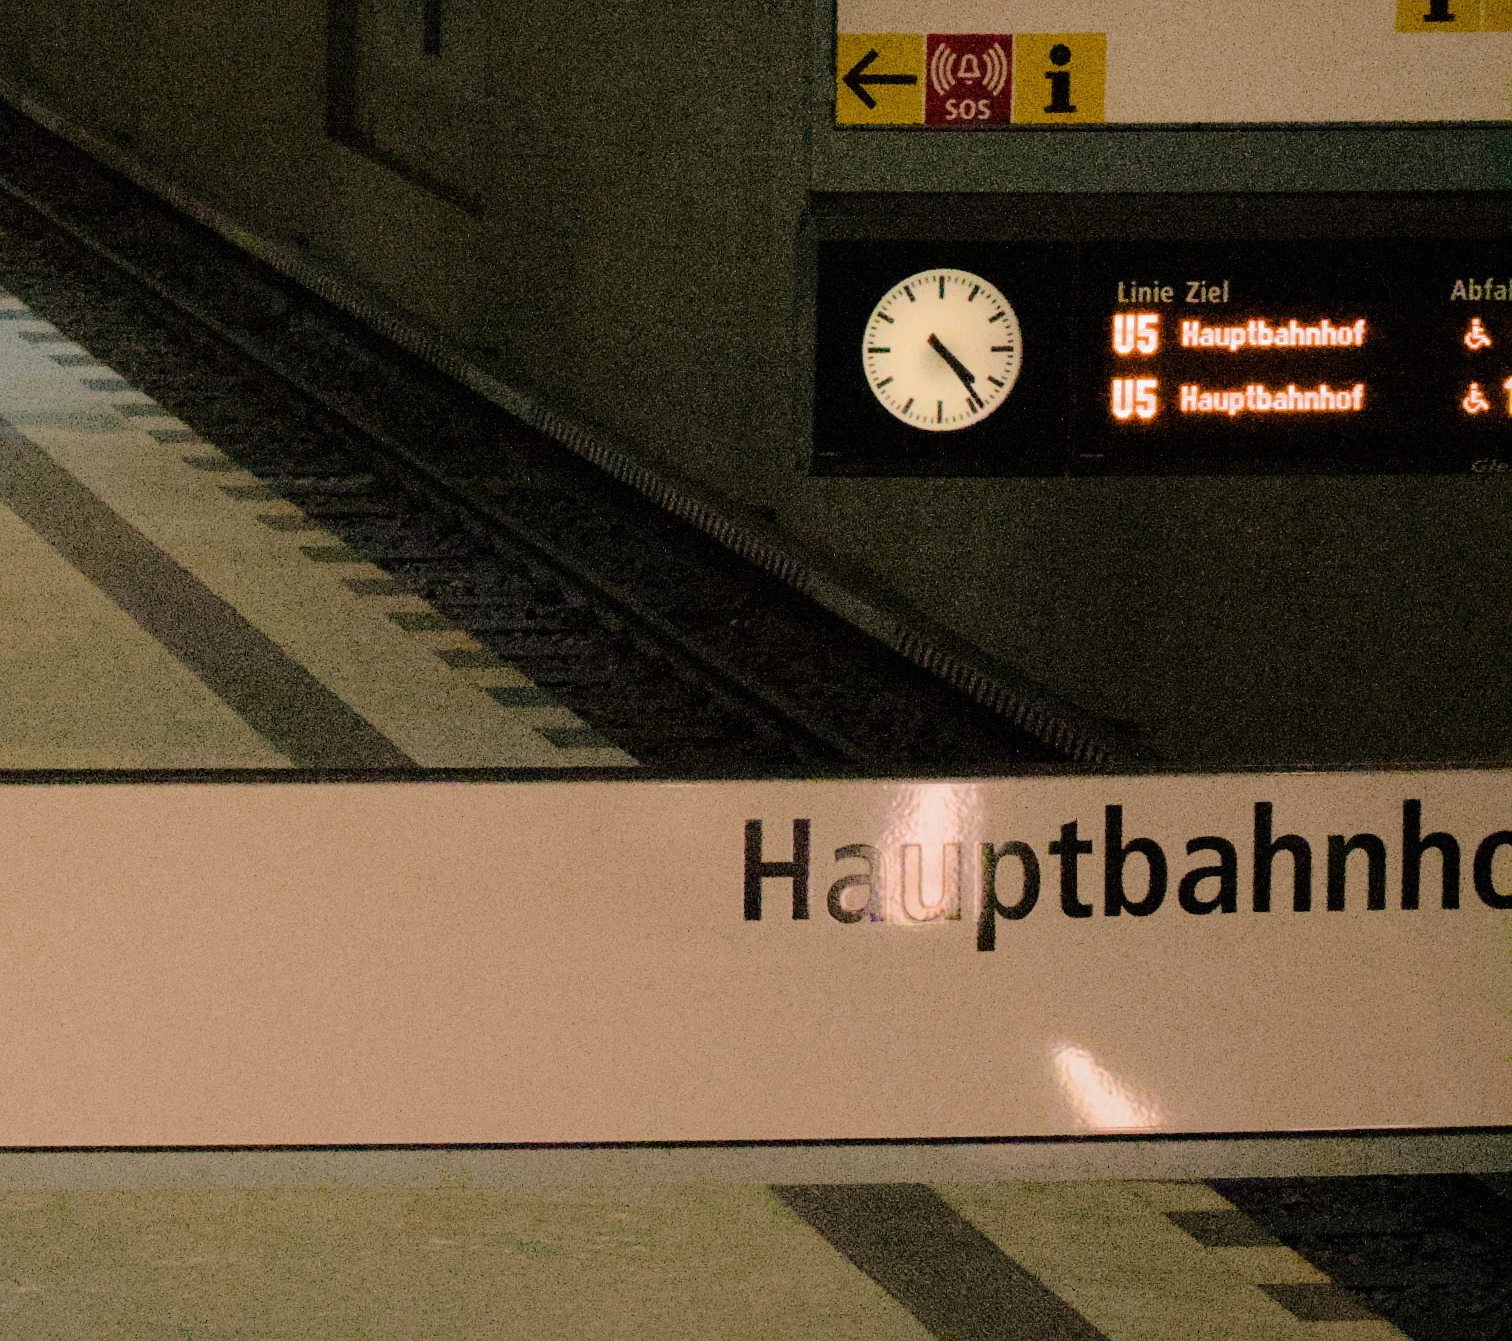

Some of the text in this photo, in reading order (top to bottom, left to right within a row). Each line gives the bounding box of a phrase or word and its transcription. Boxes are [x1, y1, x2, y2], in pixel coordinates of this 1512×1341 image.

[944, 98, 992, 121] SOS
[1117, 280, 1230, 304] Linie Ziel
[1112, 313, 1366, 356] U5 Hauptbahnhof
[1111, 377, 1364, 420] U5 Hauptbahnhof
